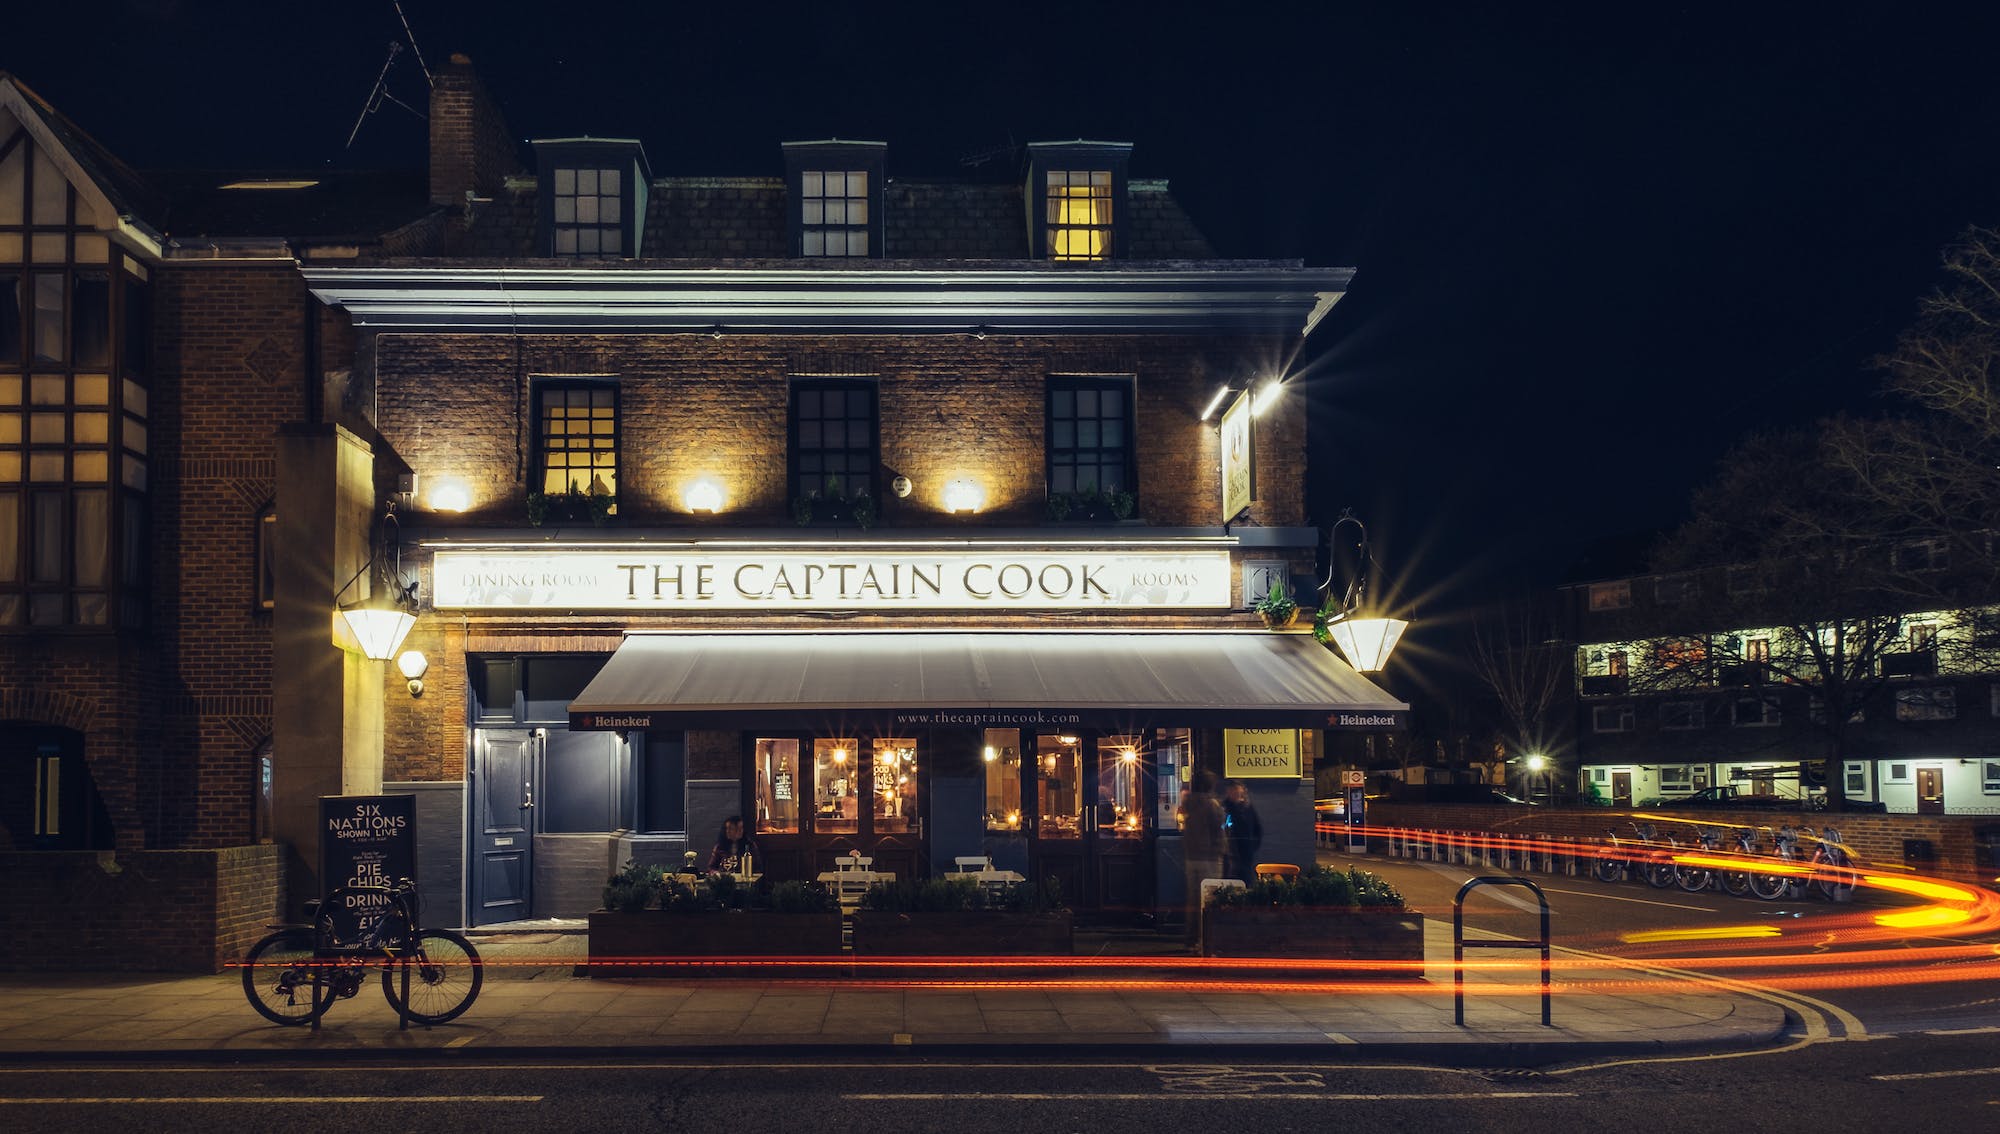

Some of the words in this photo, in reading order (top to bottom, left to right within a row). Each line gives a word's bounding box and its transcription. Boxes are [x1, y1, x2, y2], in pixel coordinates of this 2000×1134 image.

[462, 572, 535, 588] DINING
[542, 573, 598, 588] ROOM
[617, 564, 715, 600] THE
[734, 564, 942, 600] CAPTAIN
[963, 564, 1112, 600] COOK
[1131, 573, 1200, 587] ROOMS
[595, 716, 651, 727] Heineken
[898, 711, 1080, 725] www.thecaptaincook.com
[1340, 714, 1395, 726] Heineken
[1235, 744, 1290, 755] TERRACE
[1236, 757, 1288, 767] GARDEN
[356, 804, 381, 817] SIX
[329, 816, 406, 831] NATIONS
[337, 830, 371, 839] SHOWN
[375, 828, 398, 837] LIVE
[357, 863, 382, 877] PIE
[347, 875, 392, 888] CHIPS
